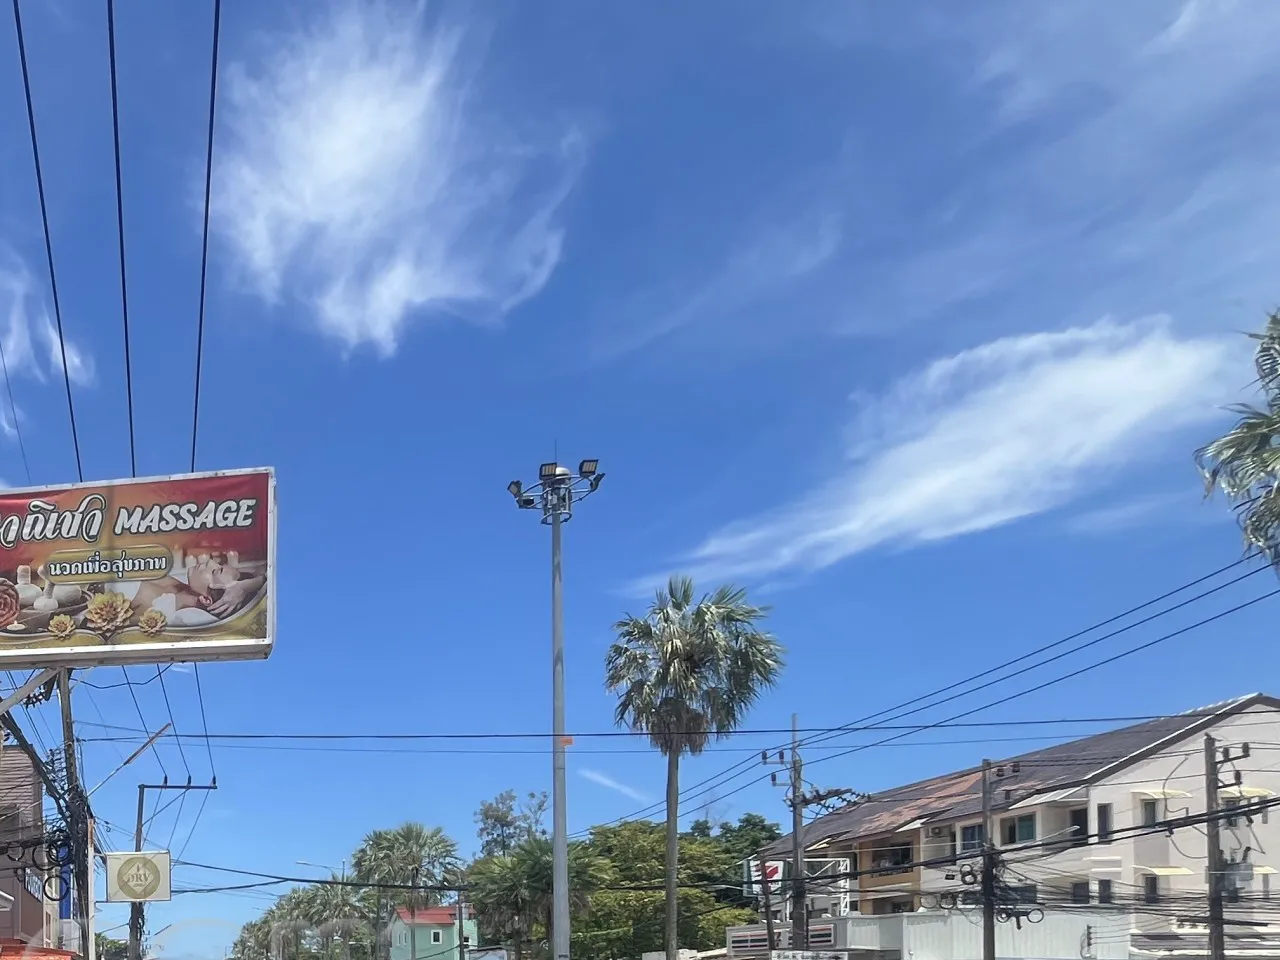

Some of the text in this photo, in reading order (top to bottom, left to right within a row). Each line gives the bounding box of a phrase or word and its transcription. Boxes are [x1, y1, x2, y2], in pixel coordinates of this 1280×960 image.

[114, 498, 258, 537] MASSAGE
[49, 551, 167, 578] นวดเพื่อสุขภาพ
